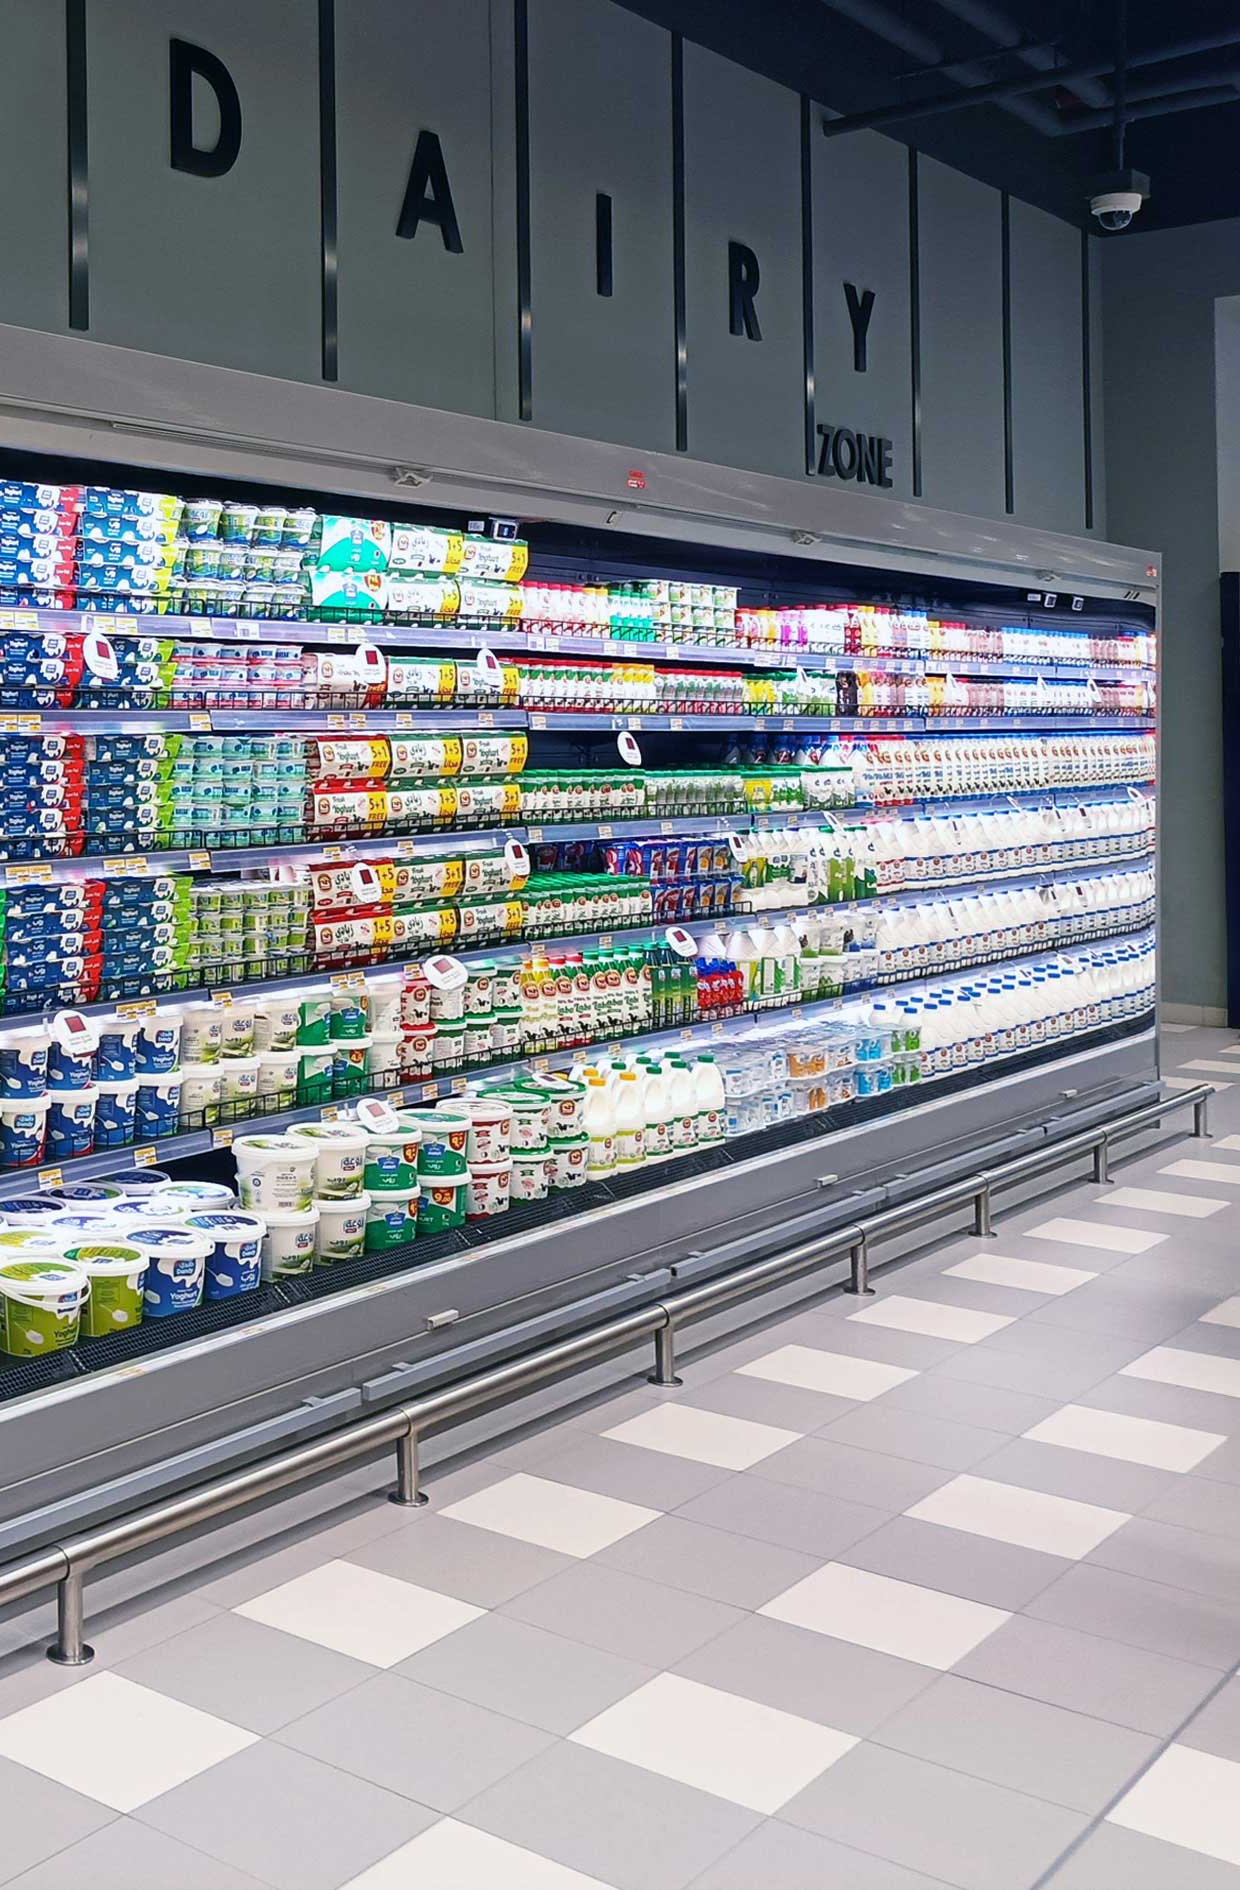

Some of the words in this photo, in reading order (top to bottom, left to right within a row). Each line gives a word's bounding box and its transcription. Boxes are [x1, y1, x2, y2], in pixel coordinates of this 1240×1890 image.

[170, 37, 876, 373] DAIRY
[816, 423, 894, 490] ZONE
[371, 744, 389, 759] 5+1
[443, 742, 460, 756] 1+5
[510, 742, 526, 756] 5+1
[371, 759, 390, 769] FREE
[510, 757, 525, 766] FREE
[439, 791, 457, 805] 1+5
[504, 789, 520, 803] 5+1
[368, 797, 386, 811] 5+1
[445, 866, 462, 880] 5+1
[439, 911, 456, 925] 1+5
[506, 906, 521, 919] 5+1
[373, 920, 392, 934] 1+5
[169, 1289, 198, 1302] Yoghurt
